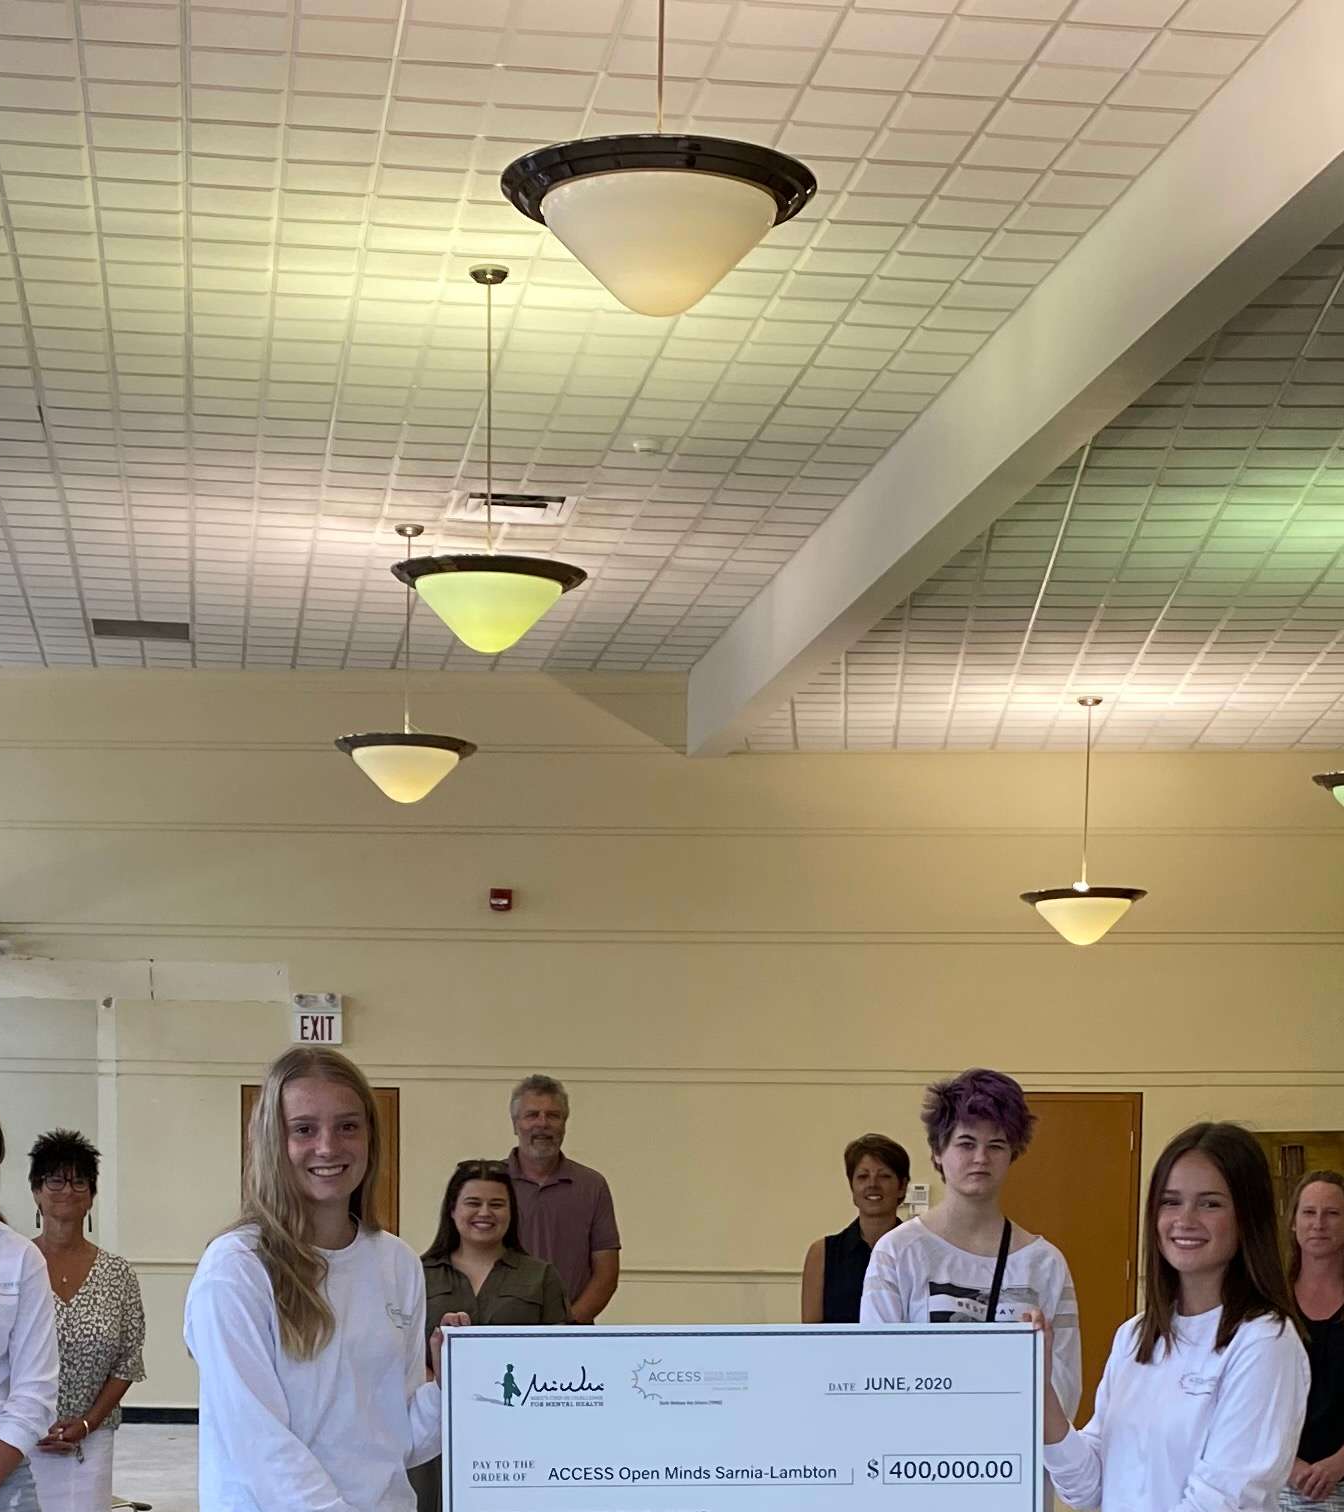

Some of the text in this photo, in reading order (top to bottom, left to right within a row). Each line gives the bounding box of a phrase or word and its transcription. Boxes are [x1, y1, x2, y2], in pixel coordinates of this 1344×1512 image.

[300, 1015, 335, 1041] EXIT
[957, 1301, 985, 1314] BEST
[648, 1371, 702, 1382] ACCESS
[828, 1377, 952, 1392] DATE JUNE, 2020
[472, 1460, 535, 1469] PAY TO THE
[867, 1458, 1013, 1481] $ 400,000.00
[472, 1472, 527, 1482] ORDER OF
[548, 1465, 837, 1483] ACCESS Open Minds Sarnia-Lambton
